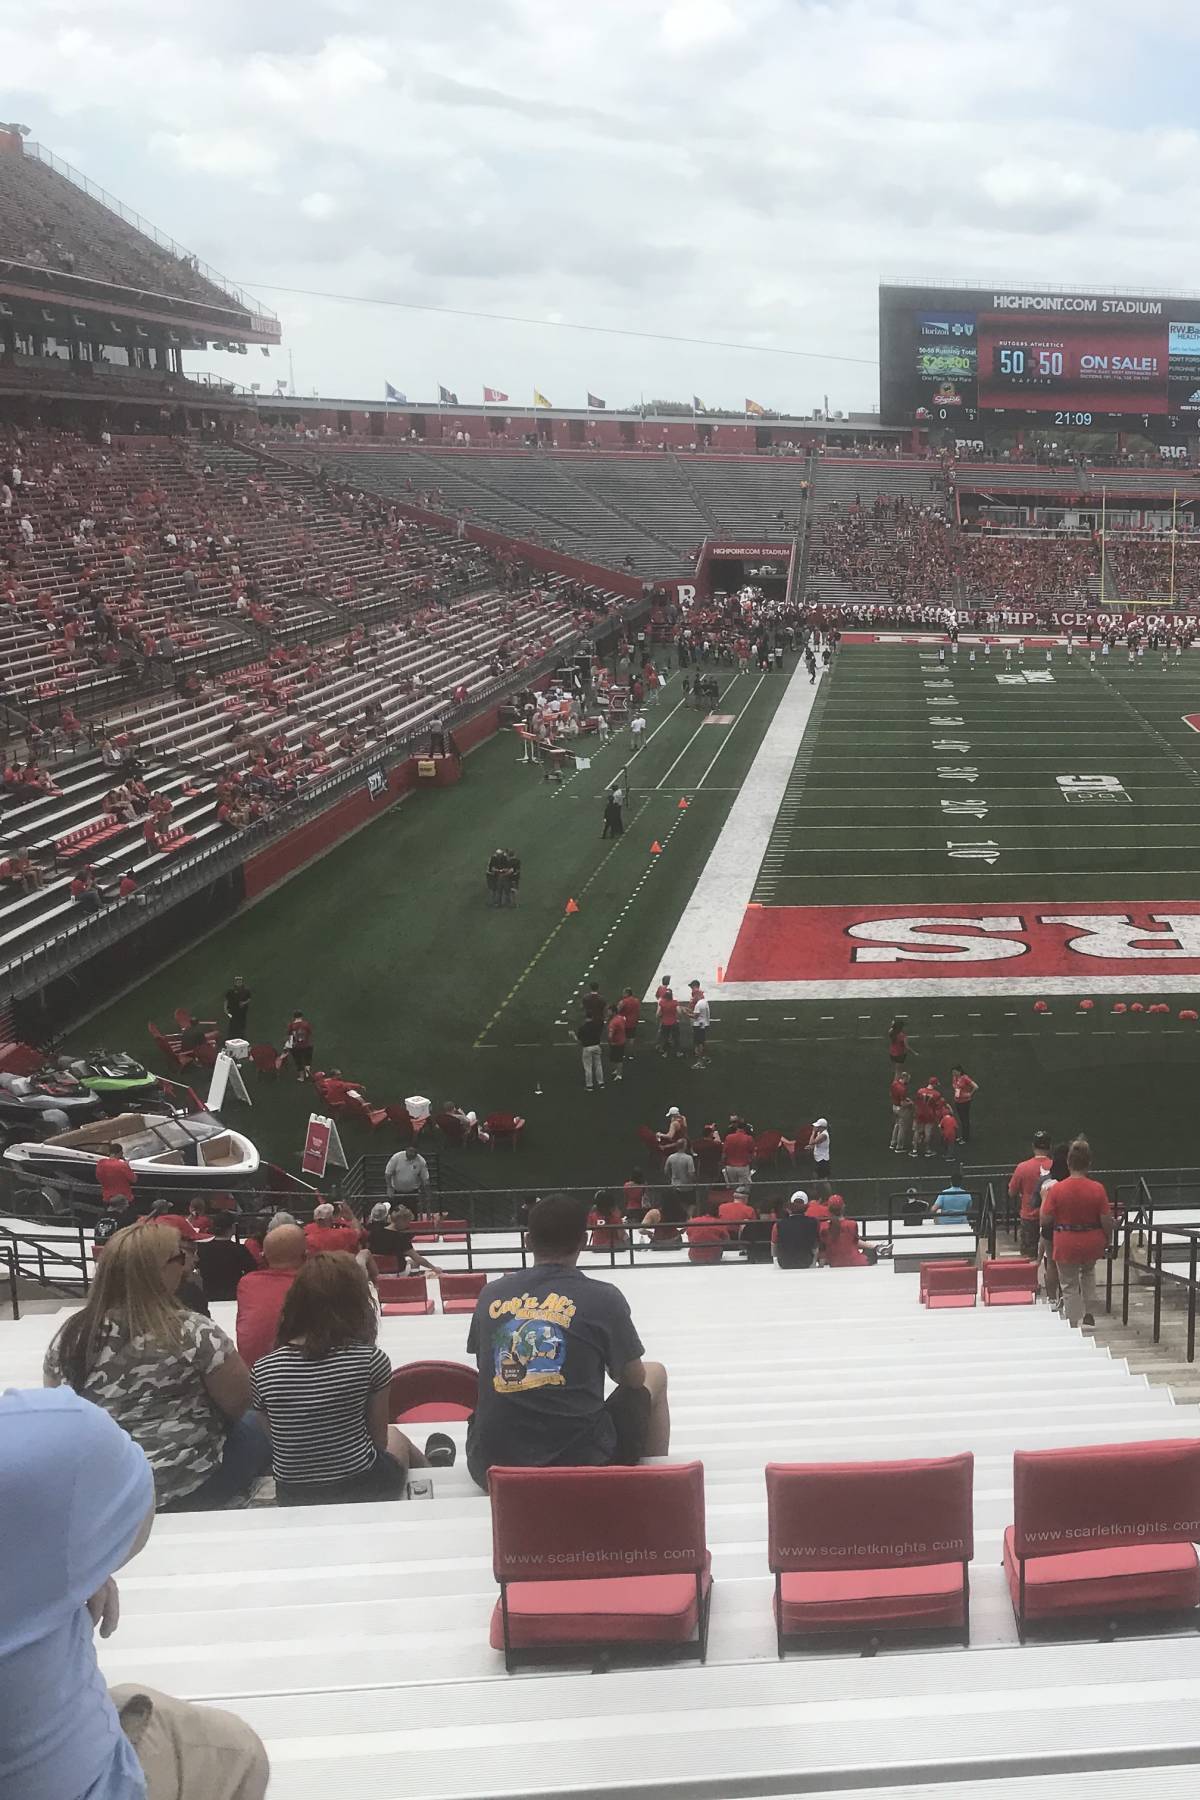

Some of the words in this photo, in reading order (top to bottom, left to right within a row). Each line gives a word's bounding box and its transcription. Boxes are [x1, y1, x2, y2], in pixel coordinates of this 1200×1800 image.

[993, 295, 1097, 312] HIGHPOINT.COM
[1102, 300, 1162, 315] STADIUM
[1000, 350, 1024, 374] 50
[1039, 351, 1063, 376] 50
[1080, 355, 1108, 369] ON
[1111, 356, 1157, 371] SALE!
[939, 408, 947, 419] 0
[1054, 412, 1092, 425] 21:09
[677, 584, 696, 605] R
[946, 840, 1001, 858] 10
